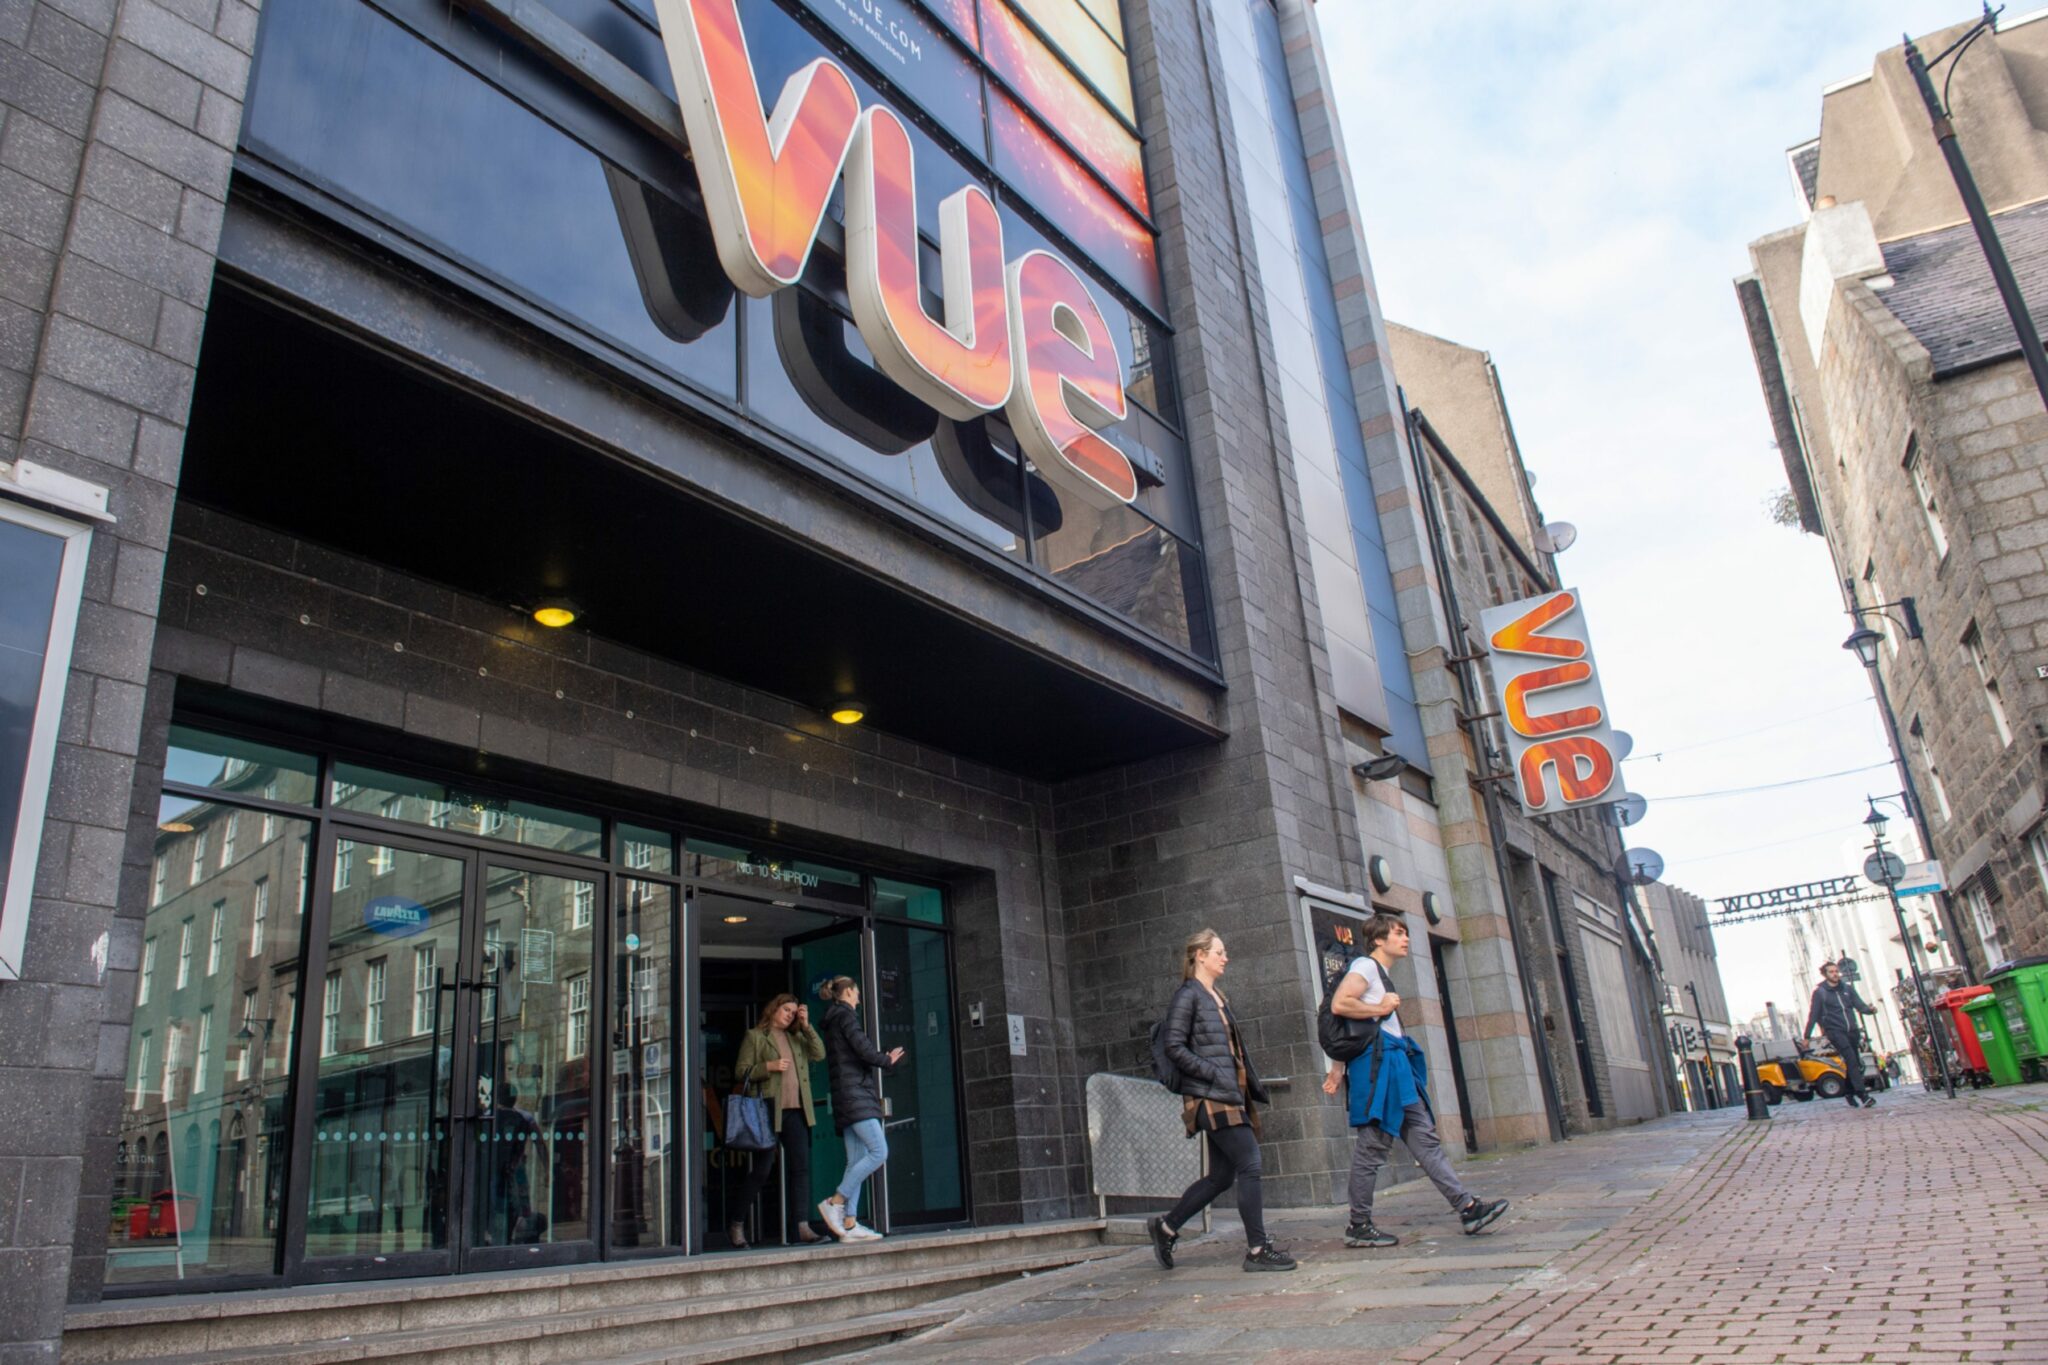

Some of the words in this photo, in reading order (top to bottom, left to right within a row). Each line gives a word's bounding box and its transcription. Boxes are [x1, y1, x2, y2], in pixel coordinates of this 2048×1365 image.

[855, 0, 921, 61] UE.COM
[865, 23, 905, 64] exclusions
[1491, 591, 1615, 809] vue
[771, 867, 819, 888] SHIPROW
